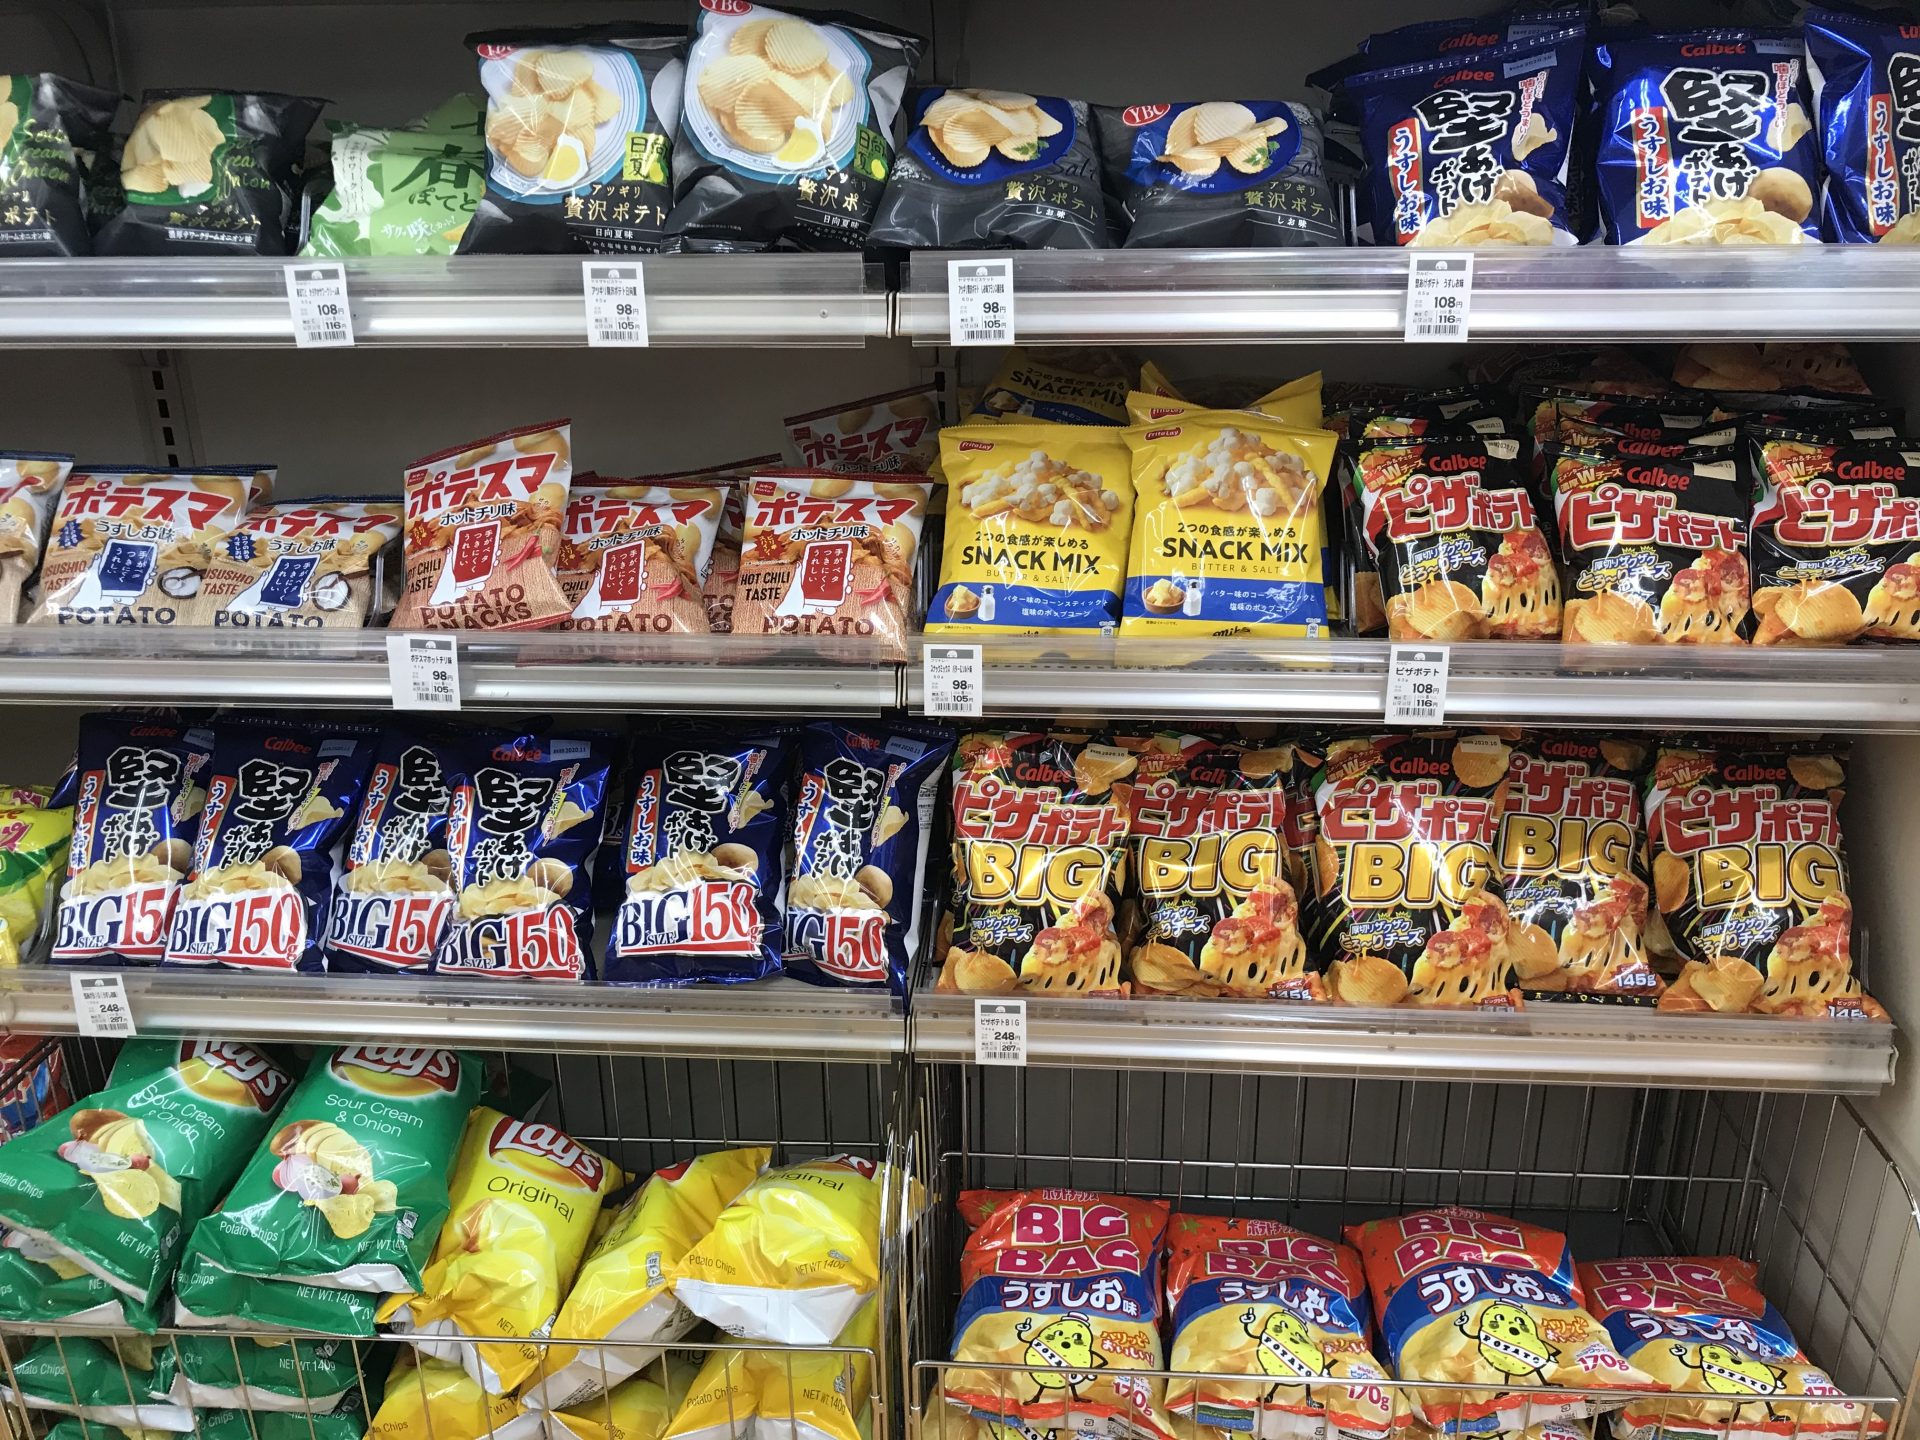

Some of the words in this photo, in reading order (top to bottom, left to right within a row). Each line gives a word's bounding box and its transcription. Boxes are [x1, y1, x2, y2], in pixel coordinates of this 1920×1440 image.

[1680, 43, 1746, 57] Calbee
[1128, 103, 1165, 123] YBC
[1459, 146, 1502, 203] あげ
[1641, 117, 1669, 218] うすしお味
[1712, 143, 1757, 198] あげ
[1873, 102, 1897, 225] うすしお味
[1270, 181, 1316, 196] アツギリ
[1394, 127, 1422, 233] うすしお味
[1432, 160, 1458, 217] ポテト
[408, 187, 478, 212] ぽてと
[563, 196, 666, 227] 贅沢ポテト
[1004, 180, 1098, 220] 贅沢ポテト
[1035, 206, 1066, 219] しお味
[1244, 191, 1337, 223] 贅沢ポテト
[595, 228, 634, 240] 日向夏味
[823, 215, 860, 230] 日向夏味
[1277, 215, 1307, 229] しお味
[983, 302, 1007, 314] 98円
[1434, 296, 1463, 309] 108円
[1009, 370, 1084, 396] SNACK
[1088, 387, 1127, 407] MIX
[803, 416, 928, 467] ポテスマ
[408, 452, 557, 520] ポテスマ
[1627, 466, 1691, 491] Calbee
[1837, 460, 1906, 481] Calbee
[60, 480, 233, 531] ポテスマ
[440, 503, 517, 526] ホットチリ味
[564, 495, 712, 535] ポテスマ
[753, 491, 917, 527] ポテスマ
[1386, 476, 1537, 539] ピザポテト
[1570, 486, 1747, 552] ピザポテト
[95, 520, 176, 543] うすしお味
[589, 526, 663, 550] ホットチリ味
[791, 525, 869, 541] ホットチリ味
[975, 530, 1089, 550] 2つの食感が楽しめる
[1177, 522, 1296, 538] 2つの食感が楽しめる
[417, 557, 442, 575] CHILI
[459, 533, 472, 567] うれしい
[470, 532, 483, 574] つきにくく
[808, 549, 820, 583] うれしい
[831, 548, 844, 583] 手がペタ
[961, 545, 1047, 571] SNACK
[1052, 551, 1101, 575] MIX
[1161, 537, 1254, 561] SNACK
[1260, 540, 1309, 564] MIX
[270, 562, 291, 592] うれしい
[606, 555, 617, 588] うれしい
[617, 552, 627, 595] つきにくく
[627, 549, 638, 585] 手がペタ
[740, 573, 761, 585] HOT
[762, 571, 791, 585] CHILI
[820, 549, 832, 592] つきにくく
[986, 569, 1029, 582] BUTTER
[1032, 574, 1040, 582] &
[1044, 574, 1071, 584] SALT
[1191, 562, 1236, 573] BUTTER
[1240, 565, 1248, 573] &
[1252, 565, 1281, 574] SALT
[203, 582, 240, 596] TASTE
[561, 580, 589, 592] CHILI
[745, 587, 782, 601] TASTE
[57, 606, 176, 625] POTATO
[214, 610, 324, 628] POTATO
[420, 583, 525, 626] POTATO
[559, 613, 673, 632] POTATO
[762, 614, 874, 635] POTATO
[1395, 667, 1440, 677] ピザポテト
[1412, 683, 1440, 694] 108円
[1541, 739, 1598, 759] Calbee
[107, 747, 181, 808] 堅
[663, 750, 742, 812] 堅
[1389, 757, 1450, 776] Calbee
[1723, 764, 1788, 782] Calbee
[234, 759, 312, 822] 堅
[476, 768, 552, 833] 堅
[631, 776, 656, 866] うすしお味
[954, 778, 1129, 846] ピザポテト
[1322, 777, 1500, 844] ピザポテト
[102, 814, 122, 864] ポテト
[218, 824, 249, 871] ポテト
[238, 820, 273, 865] あげ
[1501, 813, 1635, 875] BIG
[475, 842, 496, 887] ポテト
[495, 832, 530, 880] あげ
[968, 840, 1106, 903] BIG
[1142, 829, 1281, 894] BIG
[1346, 840, 1493, 905] BIG
[1698, 843, 1841, 908] BIG
[229, 892, 300, 960] 150g
[689, 882, 761, 944] 150g
[1349, 918, 1412, 936] 厚切りザクザク
[78, 934, 104, 948] SIZE
[190, 941, 214, 954] SIZE
[347, 933, 373, 946] SIZE
[504, 905, 581, 972] 150g
[647, 934, 676, 944] SIZE
[1615, 970, 1657, 988] 145g
[143, 1083, 181, 1115] Sour
[179, 1101, 227, 1140] Cream
[156, 1110, 200, 1142] Onion
[324, 1093, 368, 1111] Sour
[369, 1101, 424, 1129] Cream
[334, 1113, 347, 1124] &
[352, 1114, 403, 1138] Onion
[17, 1179, 44, 1199] Chips
[487, 1175, 575, 1223] Original
[116, 1231, 135, 1247] NET
[219, 1220, 250, 1237] Potato
[251, 1224, 279, 1243] Chips
[1014, 1203, 1128, 1244] BIG
[1400, 1214, 1523, 1249] BIG
[688, 1253, 713, 1267] Potato
[714, 1257, 737, 1276] Chips
[997, 1239, 1141, 1276] BAG
[1206, 1251, 1350, 1298] BAG
[1422, 1265, 1567, 1314] うすしお味
[296, 1286, 317, 1299] NET
[1003, 1277, 1139, 1317] うすしお味
[1577, 1353, 1630, 1373] 170g
[686, 1390, 713, 1408] Potato
[802, 1387, 821, 1400] NET
[383, 1421, 409, 1434] Chips
